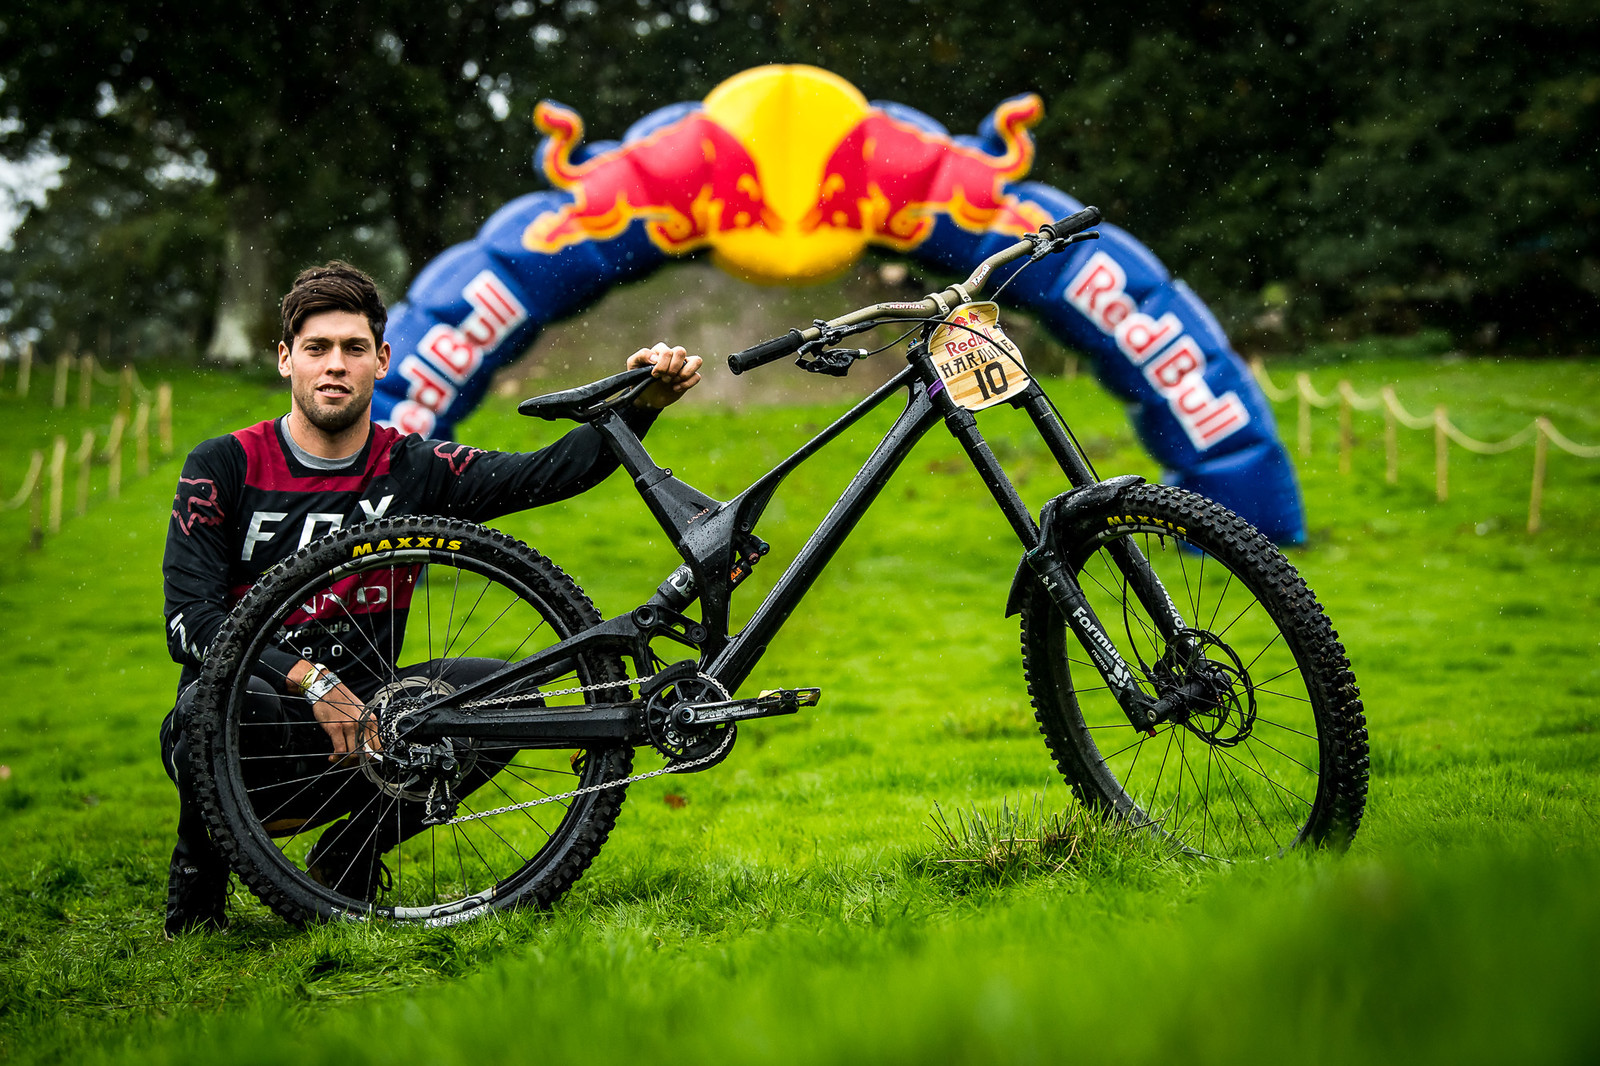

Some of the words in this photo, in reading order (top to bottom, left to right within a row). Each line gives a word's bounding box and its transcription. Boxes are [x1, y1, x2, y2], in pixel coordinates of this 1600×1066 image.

[396, 361, 452, 439] ed
[425, 276, 522, 380] Bull
[945, 332, 977, 357] Red
[1069, 258, 1176, 360] Red
[1149, 342, 1243, 446] Bull
[973, 361, 1008, 401] 10
[1107, 515, 1187, 535] MAXXIS
[352, 537, 462, 557] MAXXIS
[301, 644, 342, 659] ero
[1072, 606, 1126, 668] Formula
